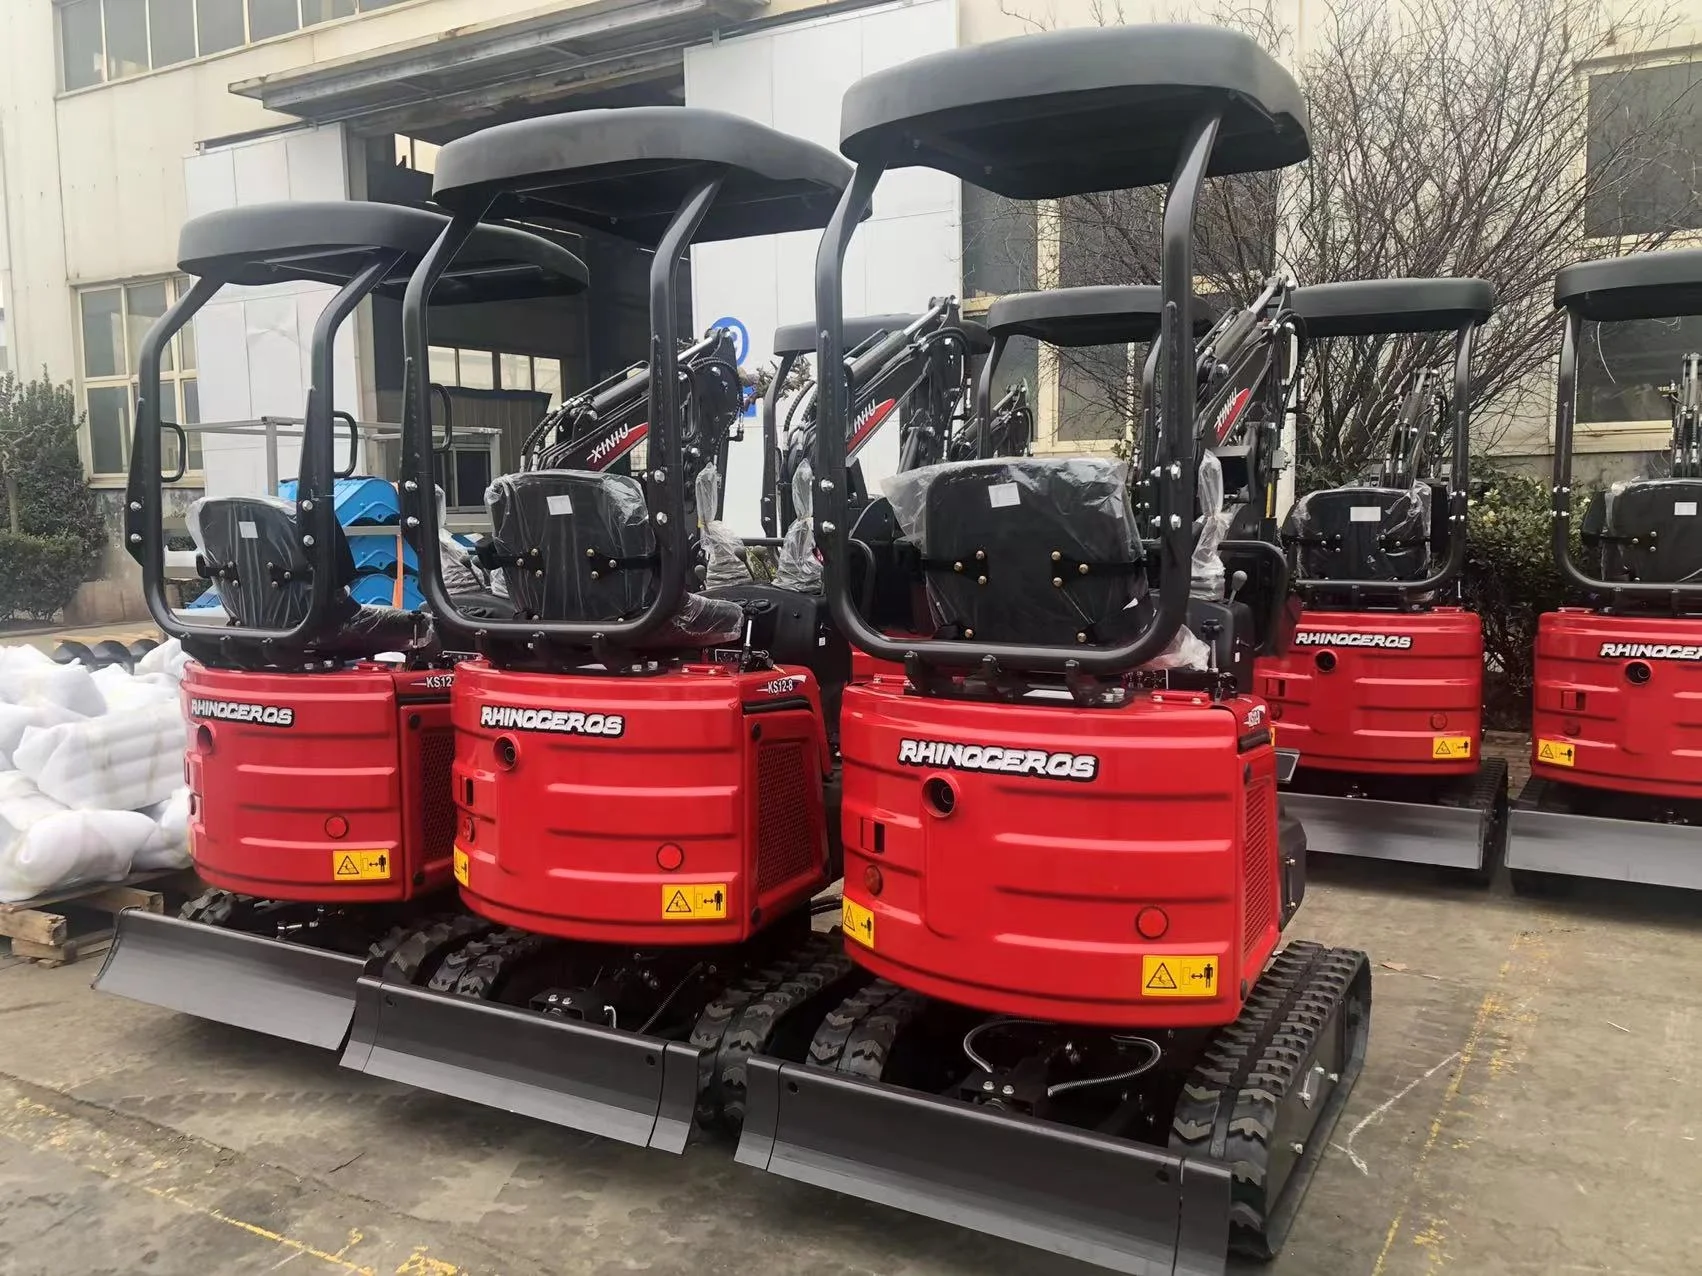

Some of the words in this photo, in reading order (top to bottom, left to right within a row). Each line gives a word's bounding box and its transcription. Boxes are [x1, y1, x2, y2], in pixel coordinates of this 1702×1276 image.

[587, 422, 629, 464] XINIU
[1295, 631, 1412, 649] RHINOCEROS
[767, 678, 793, 694] KS12-8
[191, 698, 294, 726] RHINOCEROS
[480, 704, 624, 736] RHINOCEROS
[898, 738, 1097, 779] RHINOCEROS
